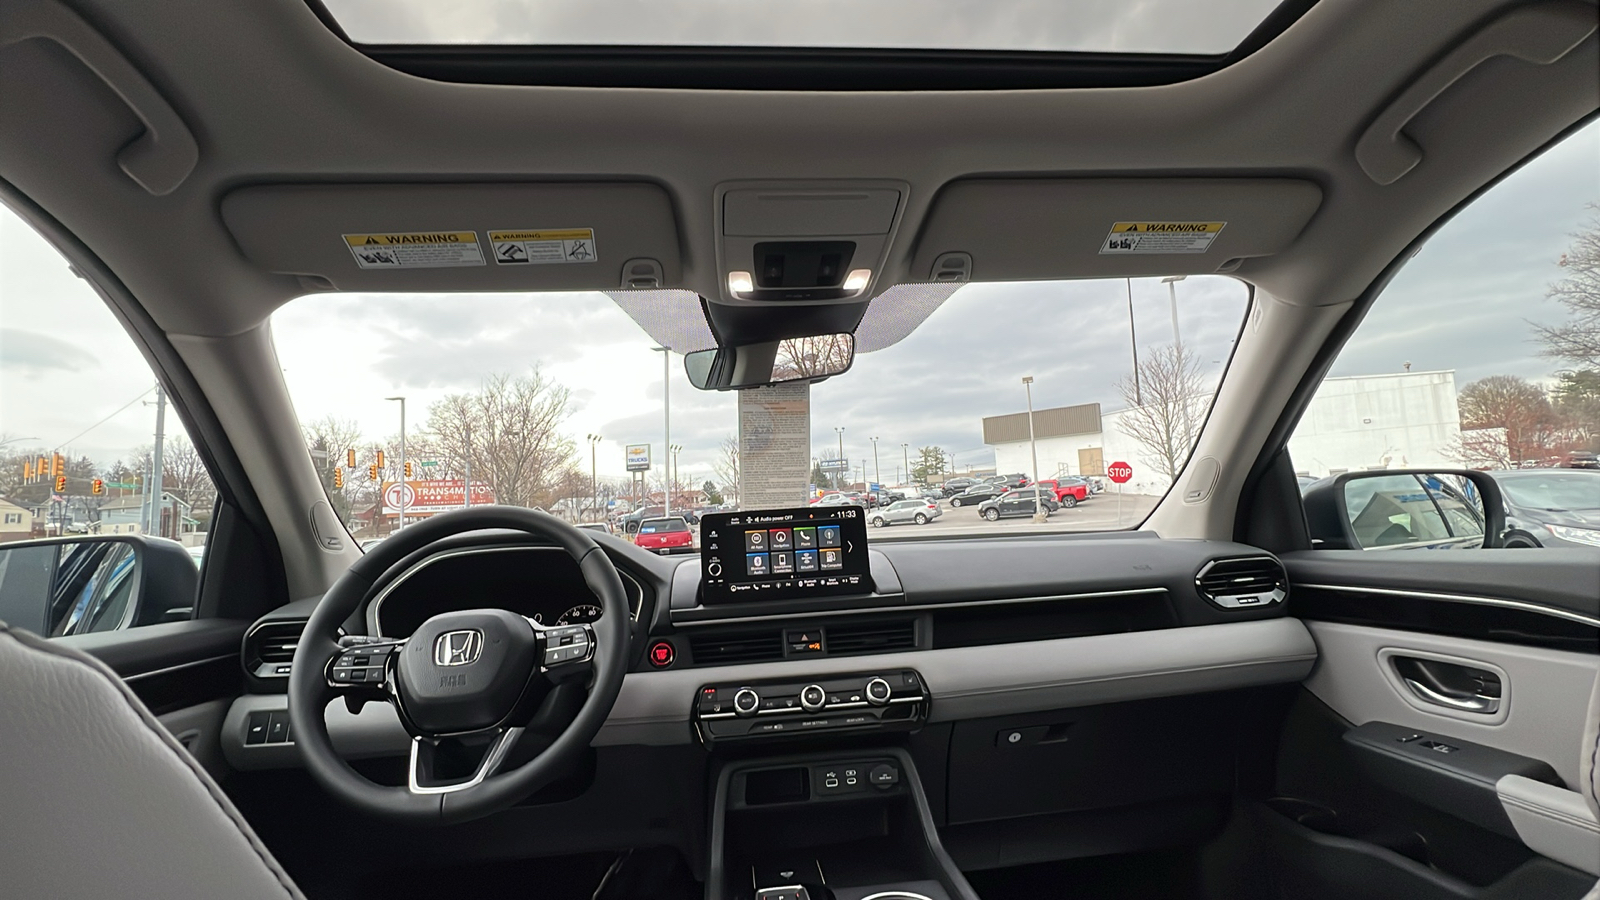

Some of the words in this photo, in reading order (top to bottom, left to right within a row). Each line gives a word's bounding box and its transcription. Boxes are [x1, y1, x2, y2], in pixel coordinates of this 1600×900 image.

[1145, 224, 1208, 232] WARNING
[385, 234, 460, 244] WARNING
[1109, 468, 1132, 478] STOP
[837, 510, 856, 518] 11:33
